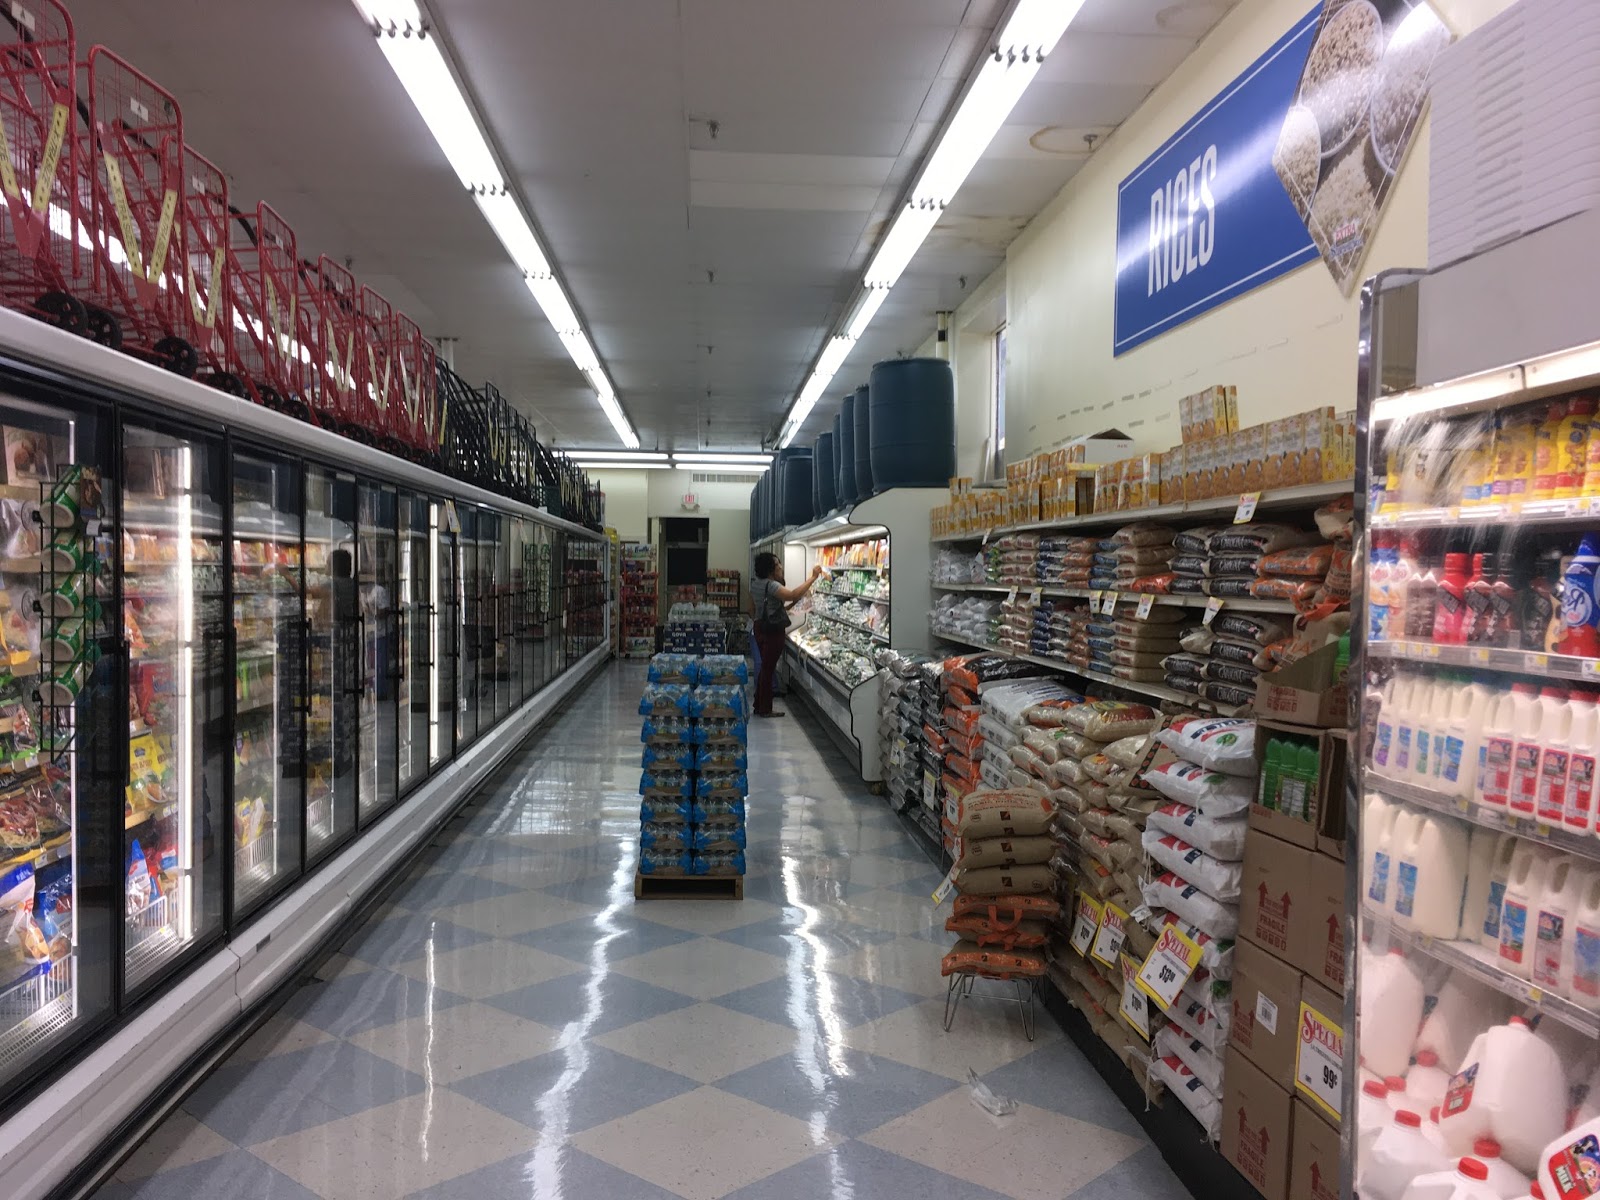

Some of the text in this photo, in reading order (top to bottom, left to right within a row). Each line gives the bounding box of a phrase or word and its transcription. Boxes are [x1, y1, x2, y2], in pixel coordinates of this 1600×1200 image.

[1148, 144, 1218, 298] RICES
[1157, 928, 1192, 962] SPECIAL
[1302, 1010, 1343, 1058] SPECIA
[1323, 1065, 1338, 1089] 99¢
[1555, 1165, 1573, 1193] MILK
